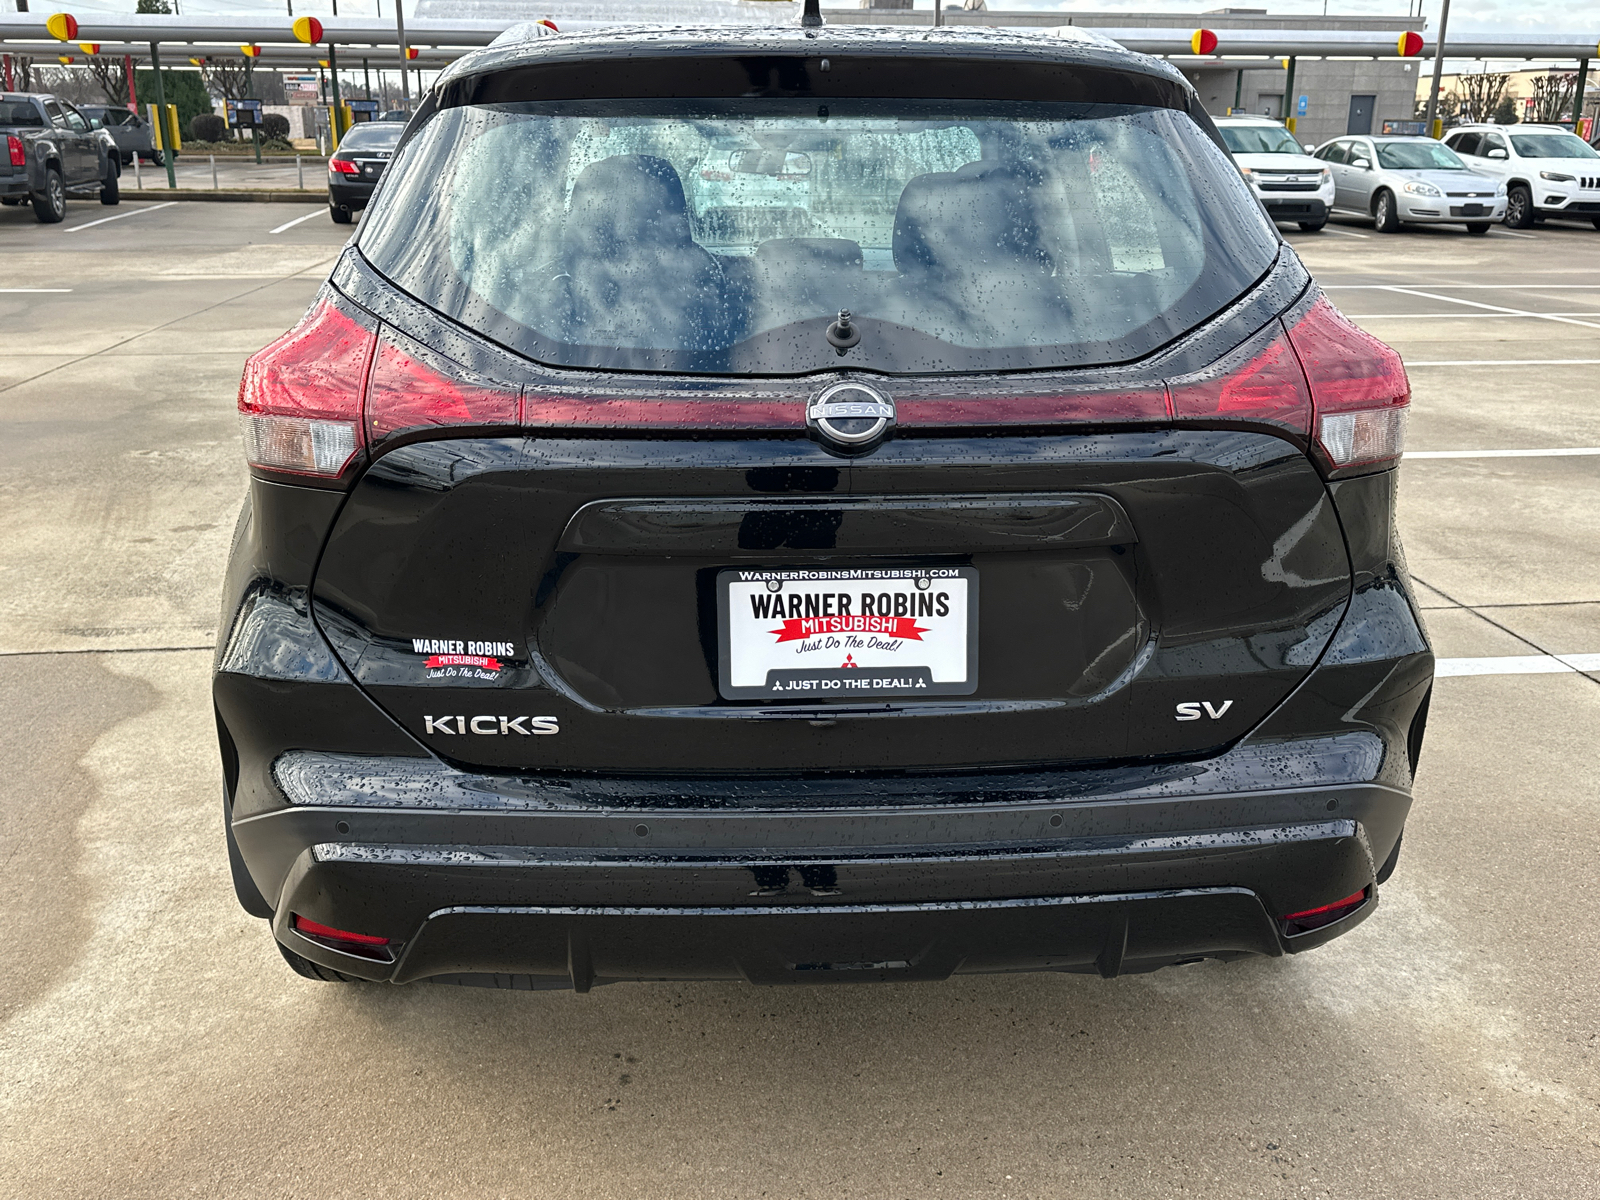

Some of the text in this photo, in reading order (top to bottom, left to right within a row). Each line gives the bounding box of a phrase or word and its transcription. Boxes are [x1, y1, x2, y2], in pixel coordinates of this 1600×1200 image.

[813, 405, 892, 416] NISSAN
[750, 591, 950, 619] WARNER ROBINS
[801, 616, 897, 634] MITSUBISHI
[412, 638, 515, 657] WARNER ROBINS
[796, 635, 903, 654] Just Do The Deal!
[438, 655, 488, 666] MITSUBISHI
[426, 667, 500, 681] Just Do The Deal!
[785, 678, 913, 690] JUST DO THE DEAL!
[1174, 700, 1234, 721] SV
[423, 715, 560, 735] KICKS
